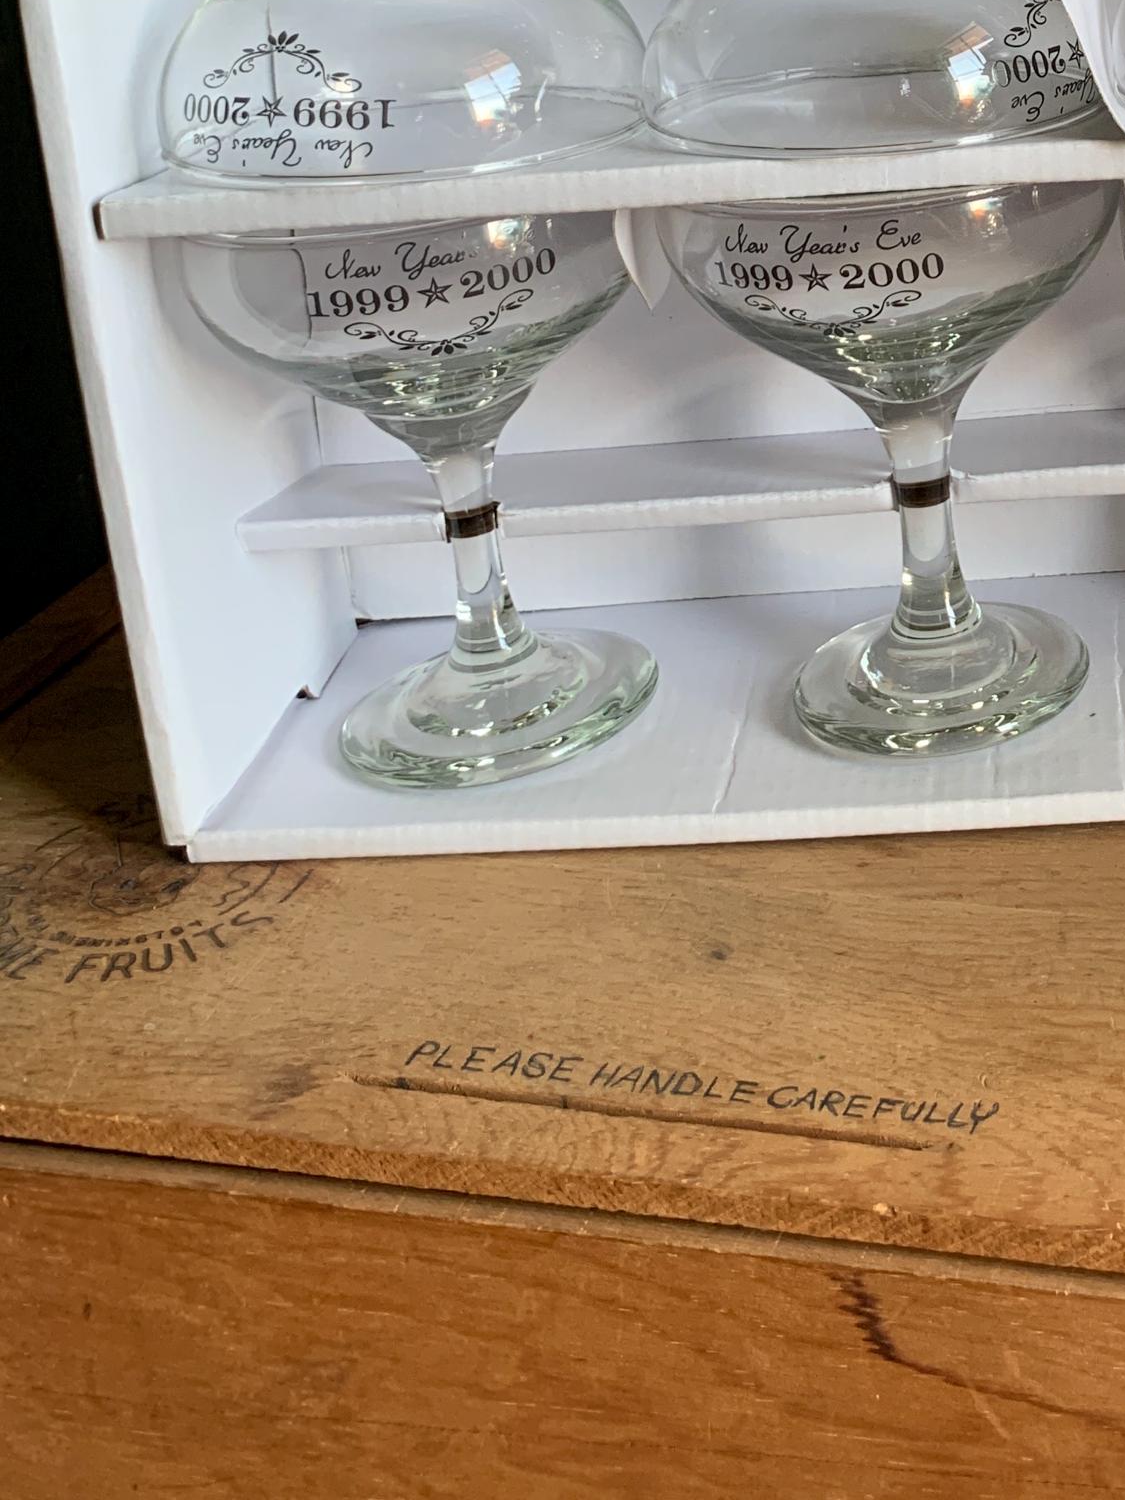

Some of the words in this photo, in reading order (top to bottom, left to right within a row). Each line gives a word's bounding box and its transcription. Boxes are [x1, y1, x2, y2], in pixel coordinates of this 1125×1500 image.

[991, 45, 1066, 88] 2000
[184, 93, 251, 126] 2000
[293, 98, 397, 131] 1999
[1011, 91, 1045, 123] Eve
[193, 134, 222, 164] Eve
[232, 129, 302, 168] Year's
[314, 139, 373, 169] New
[726, 223, 769, 254] New
[779, 224, 861, 263] Year's
[876, 219, 922, 250] Eve
[307, 284, 410, 318] 1999
[460, 247, 556, 299] 2000
[325, 248, 382, 280] New
[714, 261, 794, 292] 1999
[839, 252, 944, 290] 2000
[64, 910, 275, 984] FRUITS
[404, 1040, 584, 1082] PLEASE
[589, 1062, 759, 1103] HANDLE
[766, 1085, 1000, 1135] CAREFULLY
